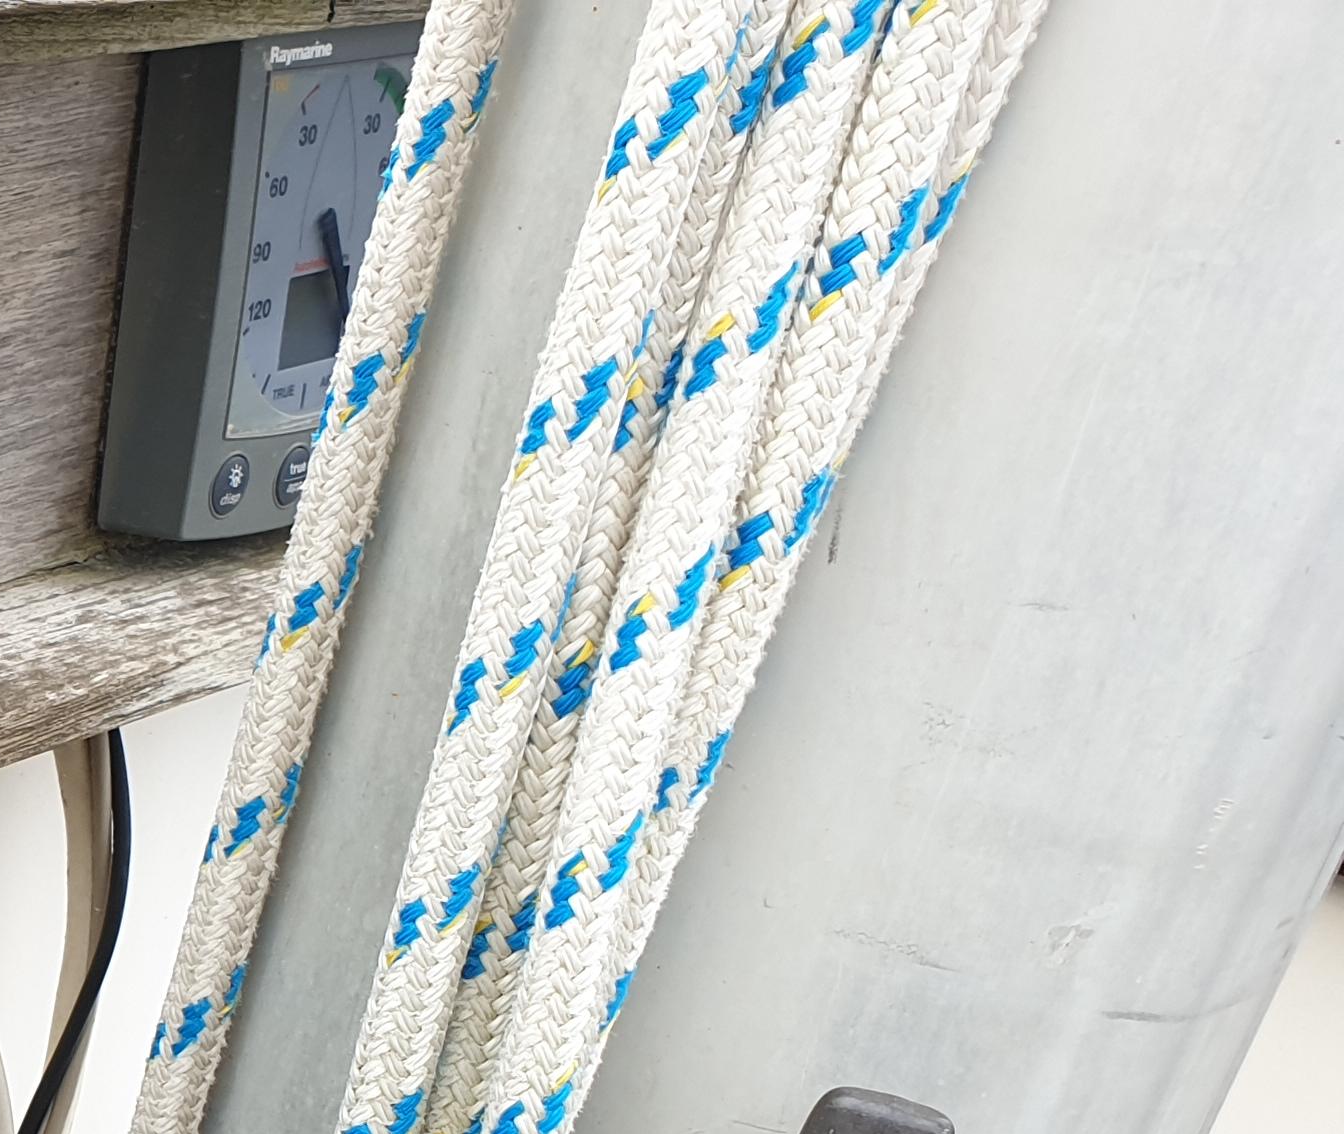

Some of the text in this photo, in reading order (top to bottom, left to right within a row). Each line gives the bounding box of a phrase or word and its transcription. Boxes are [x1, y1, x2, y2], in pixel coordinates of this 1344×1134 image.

[270, 41, 333, 66] Raymarine
[298, 124, 318, 147] 30
[362, 113, 381, 135] 30
[269, 175, 289, 198] 60
[252, 241, 271, 264] 90
[248, 298, 272, 321] 120
